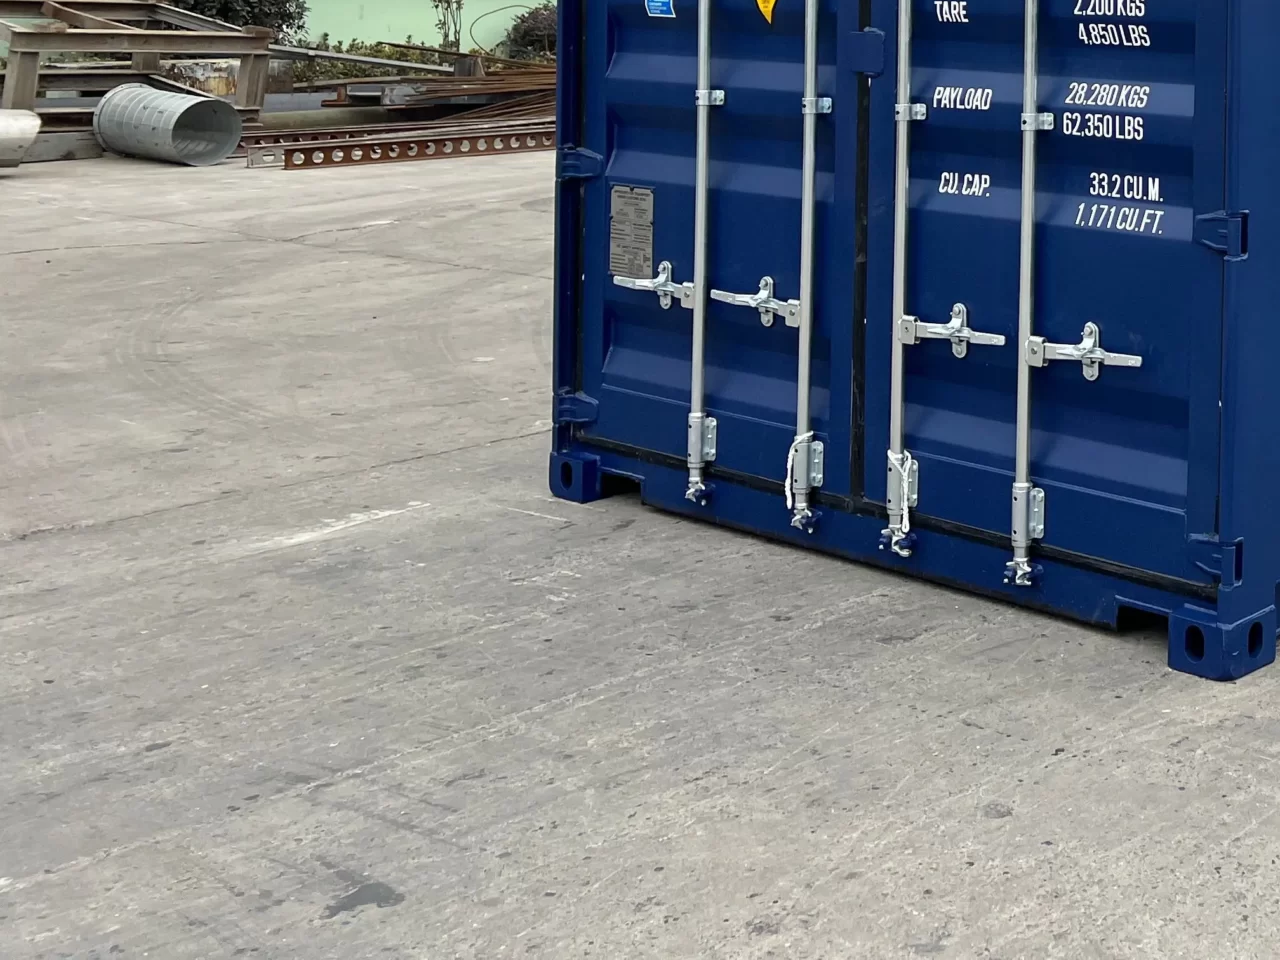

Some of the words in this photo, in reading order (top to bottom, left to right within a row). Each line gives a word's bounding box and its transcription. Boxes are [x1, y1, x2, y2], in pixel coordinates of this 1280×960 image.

[934, 0, 969, 23] TARE
[1078, 23, 1120, 45] 4,850
[1119, 24, 1151, 47] LBS
[933, 86, 993, 110] PAYLOAD
[1064, 82, 1119, 106] 28,280
[1118, 85, 1150, 108] KGS
[1063, 111, 1113, 138] 62,350
[1115, 115, 1144, 141] LBS
[938, 171, 959, 195] CU.
[961, 173, 990, 197] CAP.
[1089, 172, 1121, 198] 33.2
[1124, 175, 1164, 202] CU.M.
[1075, 203, 1116, 229] 1,171
[1115, 207, 1165, 234] CU.FT.
